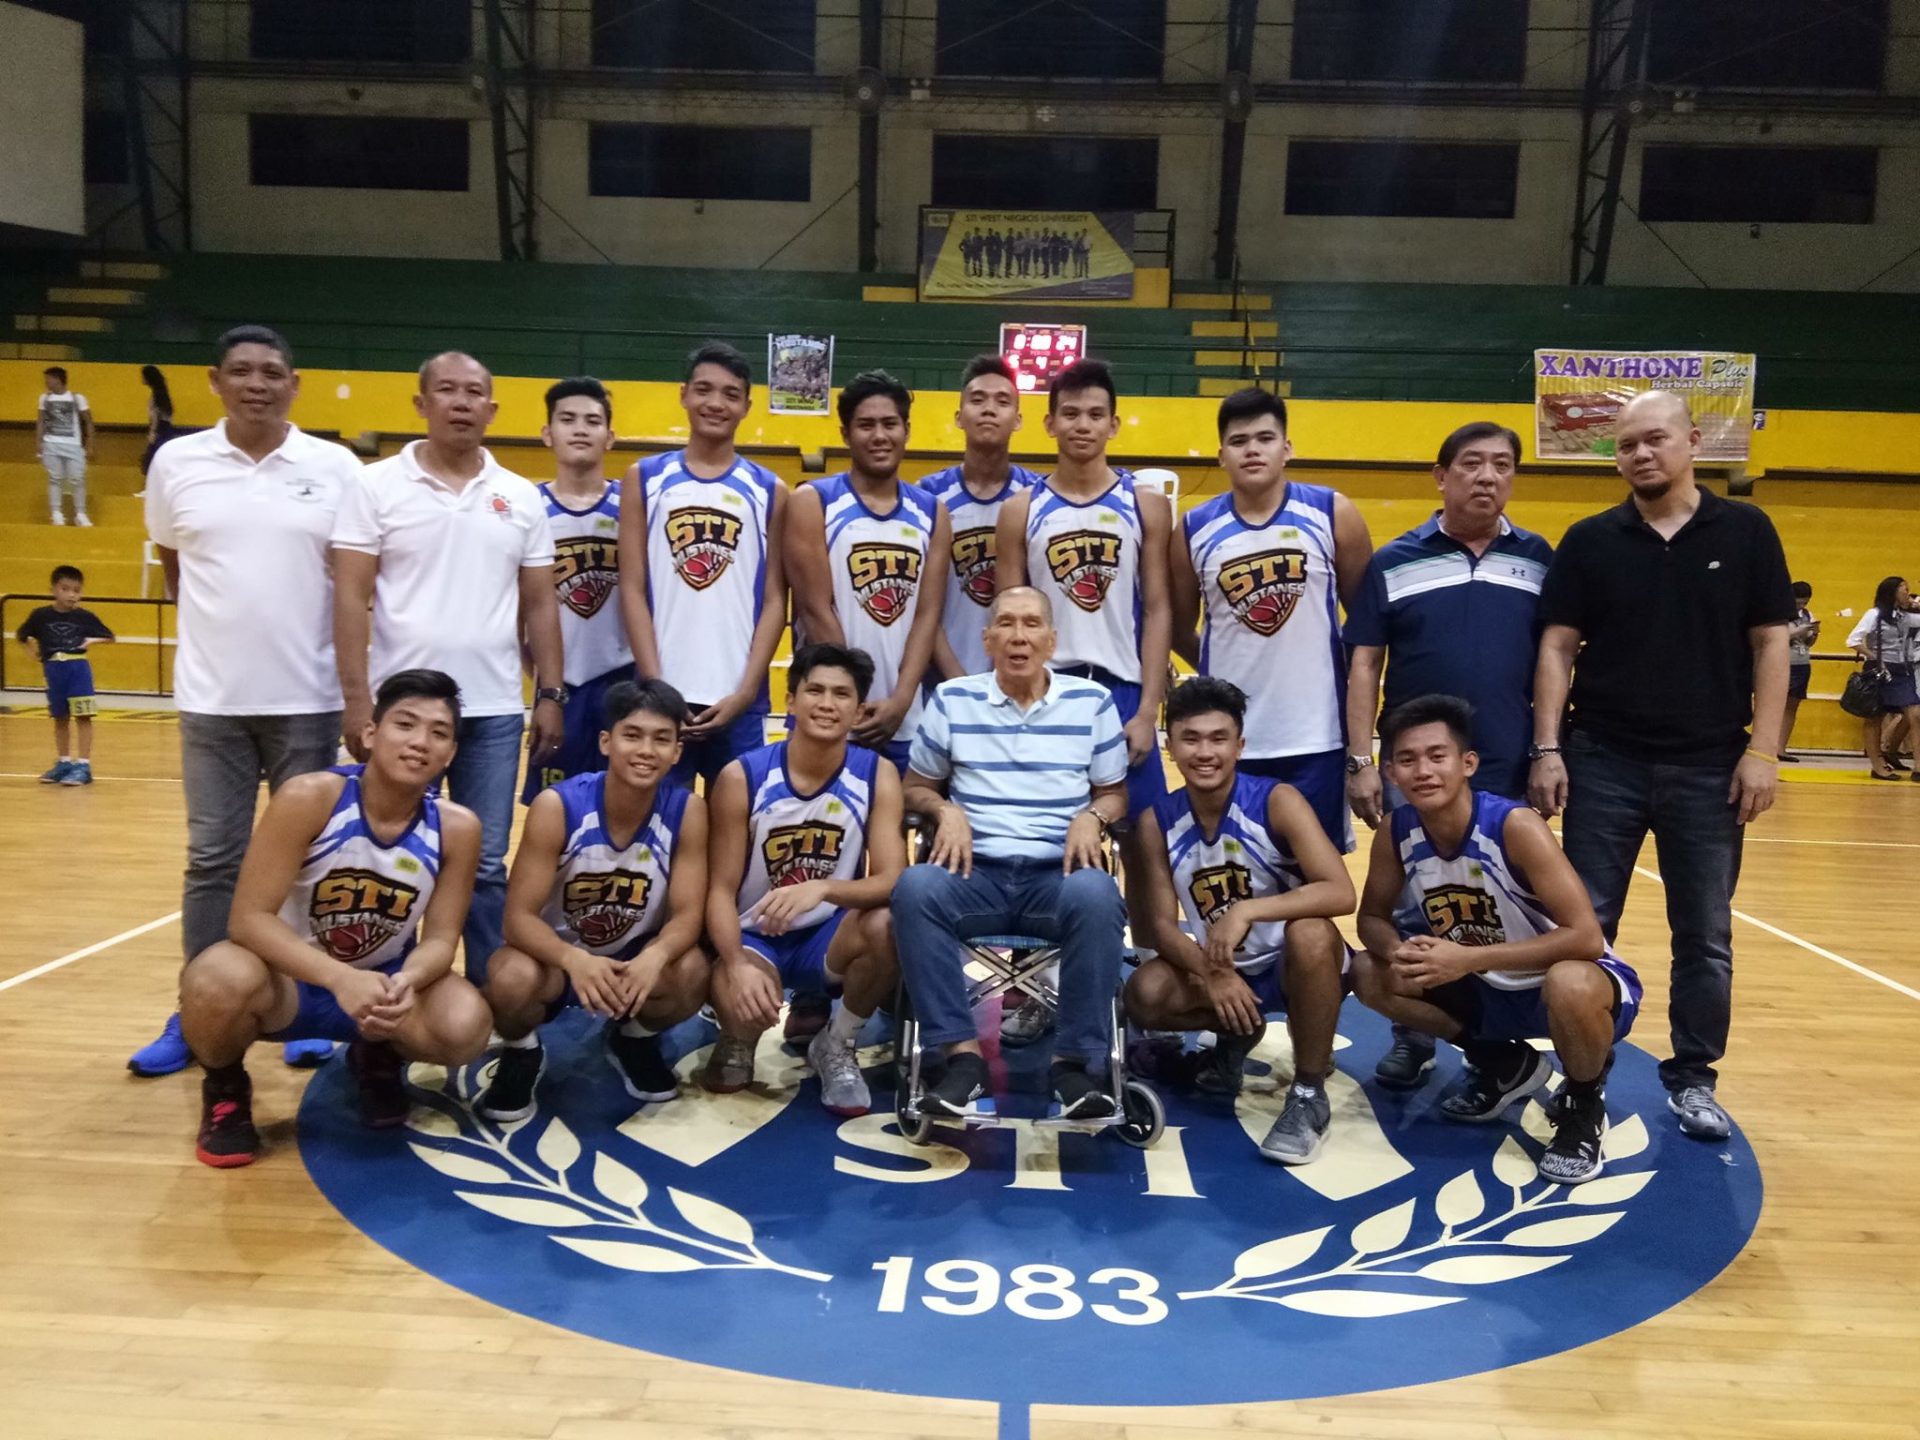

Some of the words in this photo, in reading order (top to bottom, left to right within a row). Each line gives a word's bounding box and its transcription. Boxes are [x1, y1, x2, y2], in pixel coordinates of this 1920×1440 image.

[980, 214, 1001, 222] WEST
[1004, 214, 1039, 222] NEGROS
[1041, 214, 1088, 222] UNIVERSITY
[1538, 354, 1702, 379] XANTHONE
[1710, 358, 1749, 379] Plus
[1651, 379, 1693, 389] Herbal
[1695, 380, 1745, 389] Capsule
[666, 513, 742, 554] STI
[952, 533, 997, 573] ST
[552, 542, 619, 587] STI
[673, 541, 735, 574] MUSTANGS
[849, 549, 921, 588] STI
[1047, 536, 1119, 579] STI
[854, 578, 918, 608] MUSTANGS
[1218, 554, 1304, 604] STI
[1231, 582, 1306, 620] MUSTANGS
[766, 827, 841, 873] STI
[313, 876, 416, 918] STI
[567, 875, 648, 911] STI
[1192, 868, 1248, 917] STI
[309, 911, 404, 937] MUSTANGS
[1425, 892, 1497, 936] STI
[833, 1111, 1208, 1199] STI
[871, 1256, 1169, 1326] 1983
